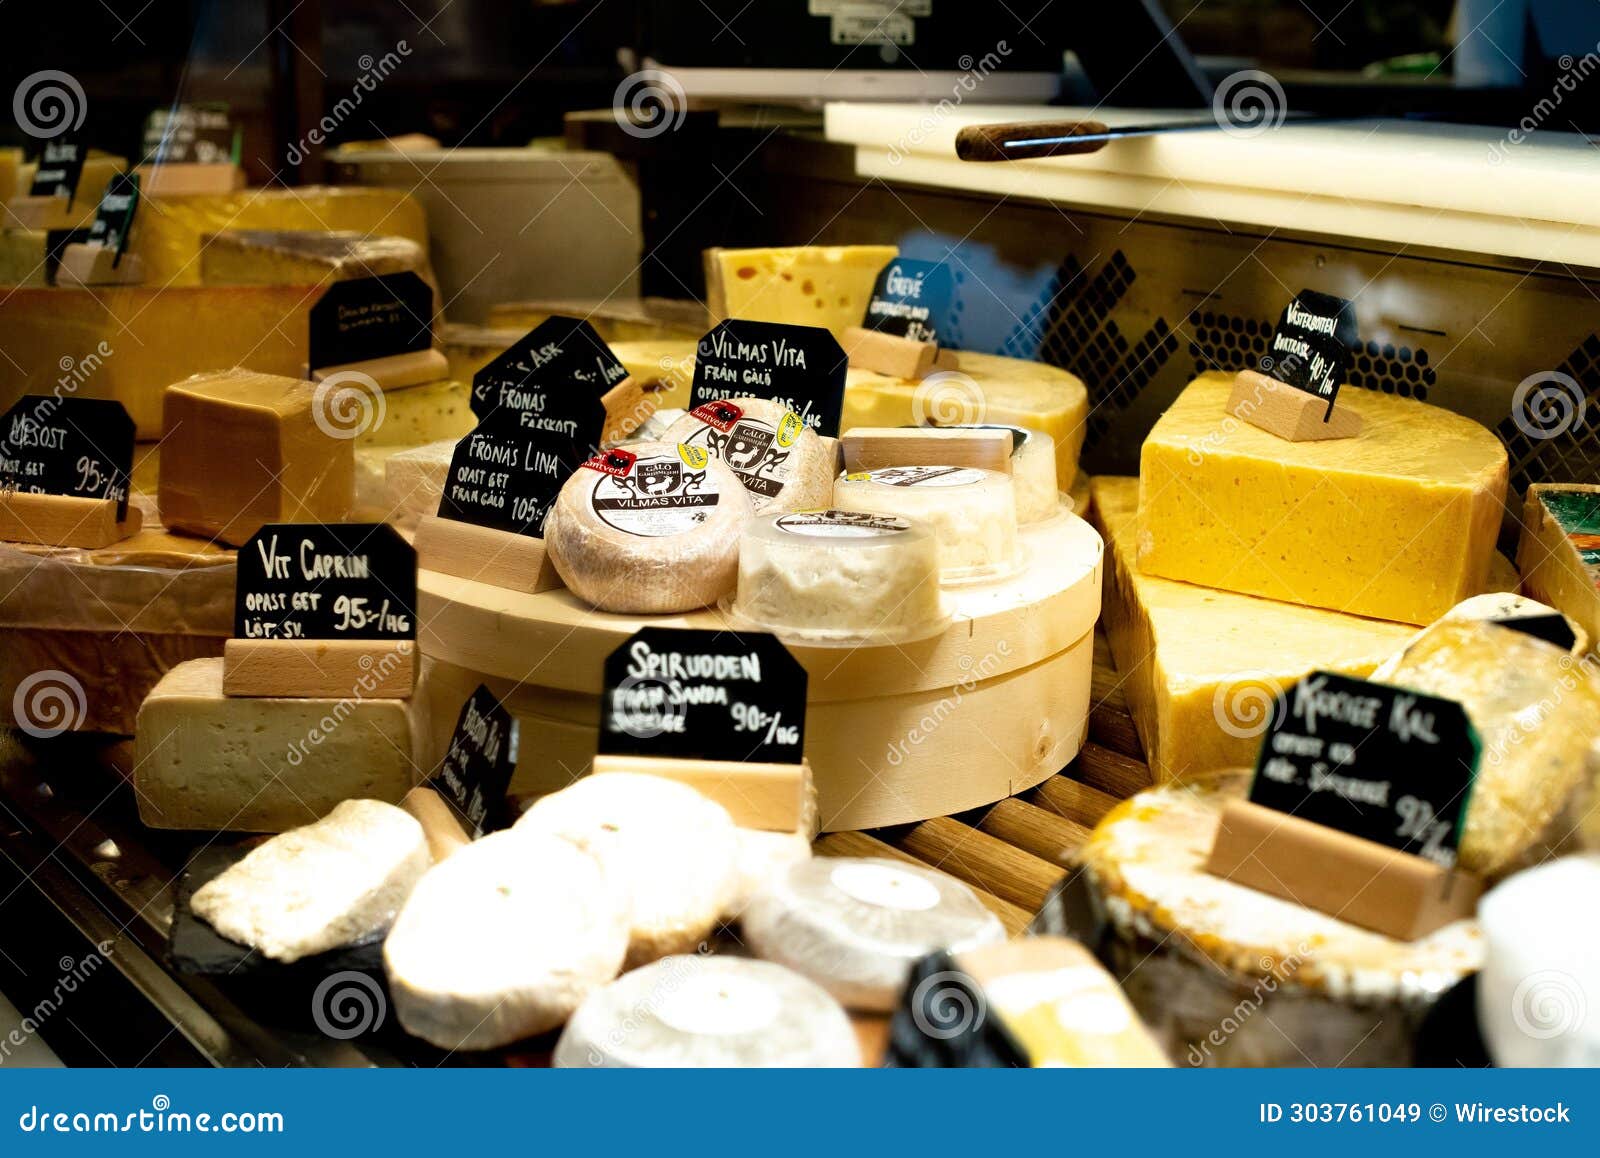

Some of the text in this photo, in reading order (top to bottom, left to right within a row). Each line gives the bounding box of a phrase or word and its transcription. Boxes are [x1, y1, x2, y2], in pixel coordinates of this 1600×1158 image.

[712, 330, 807, 369] VILMAS VITA
[704, 363, 772, 386] FRÅN GÅLÖ
[469, 434, 558, 479] FRÖNÄS LINA
[457, 466, 509, 489] OPAST GET
[743, 475, 768, 491] VITA
[617, 495, 704, 508] VILMAS VITA
[257, 534, 369, 581] VIT CAPRIN
[246, 592, 322, 611] OPAST GET
